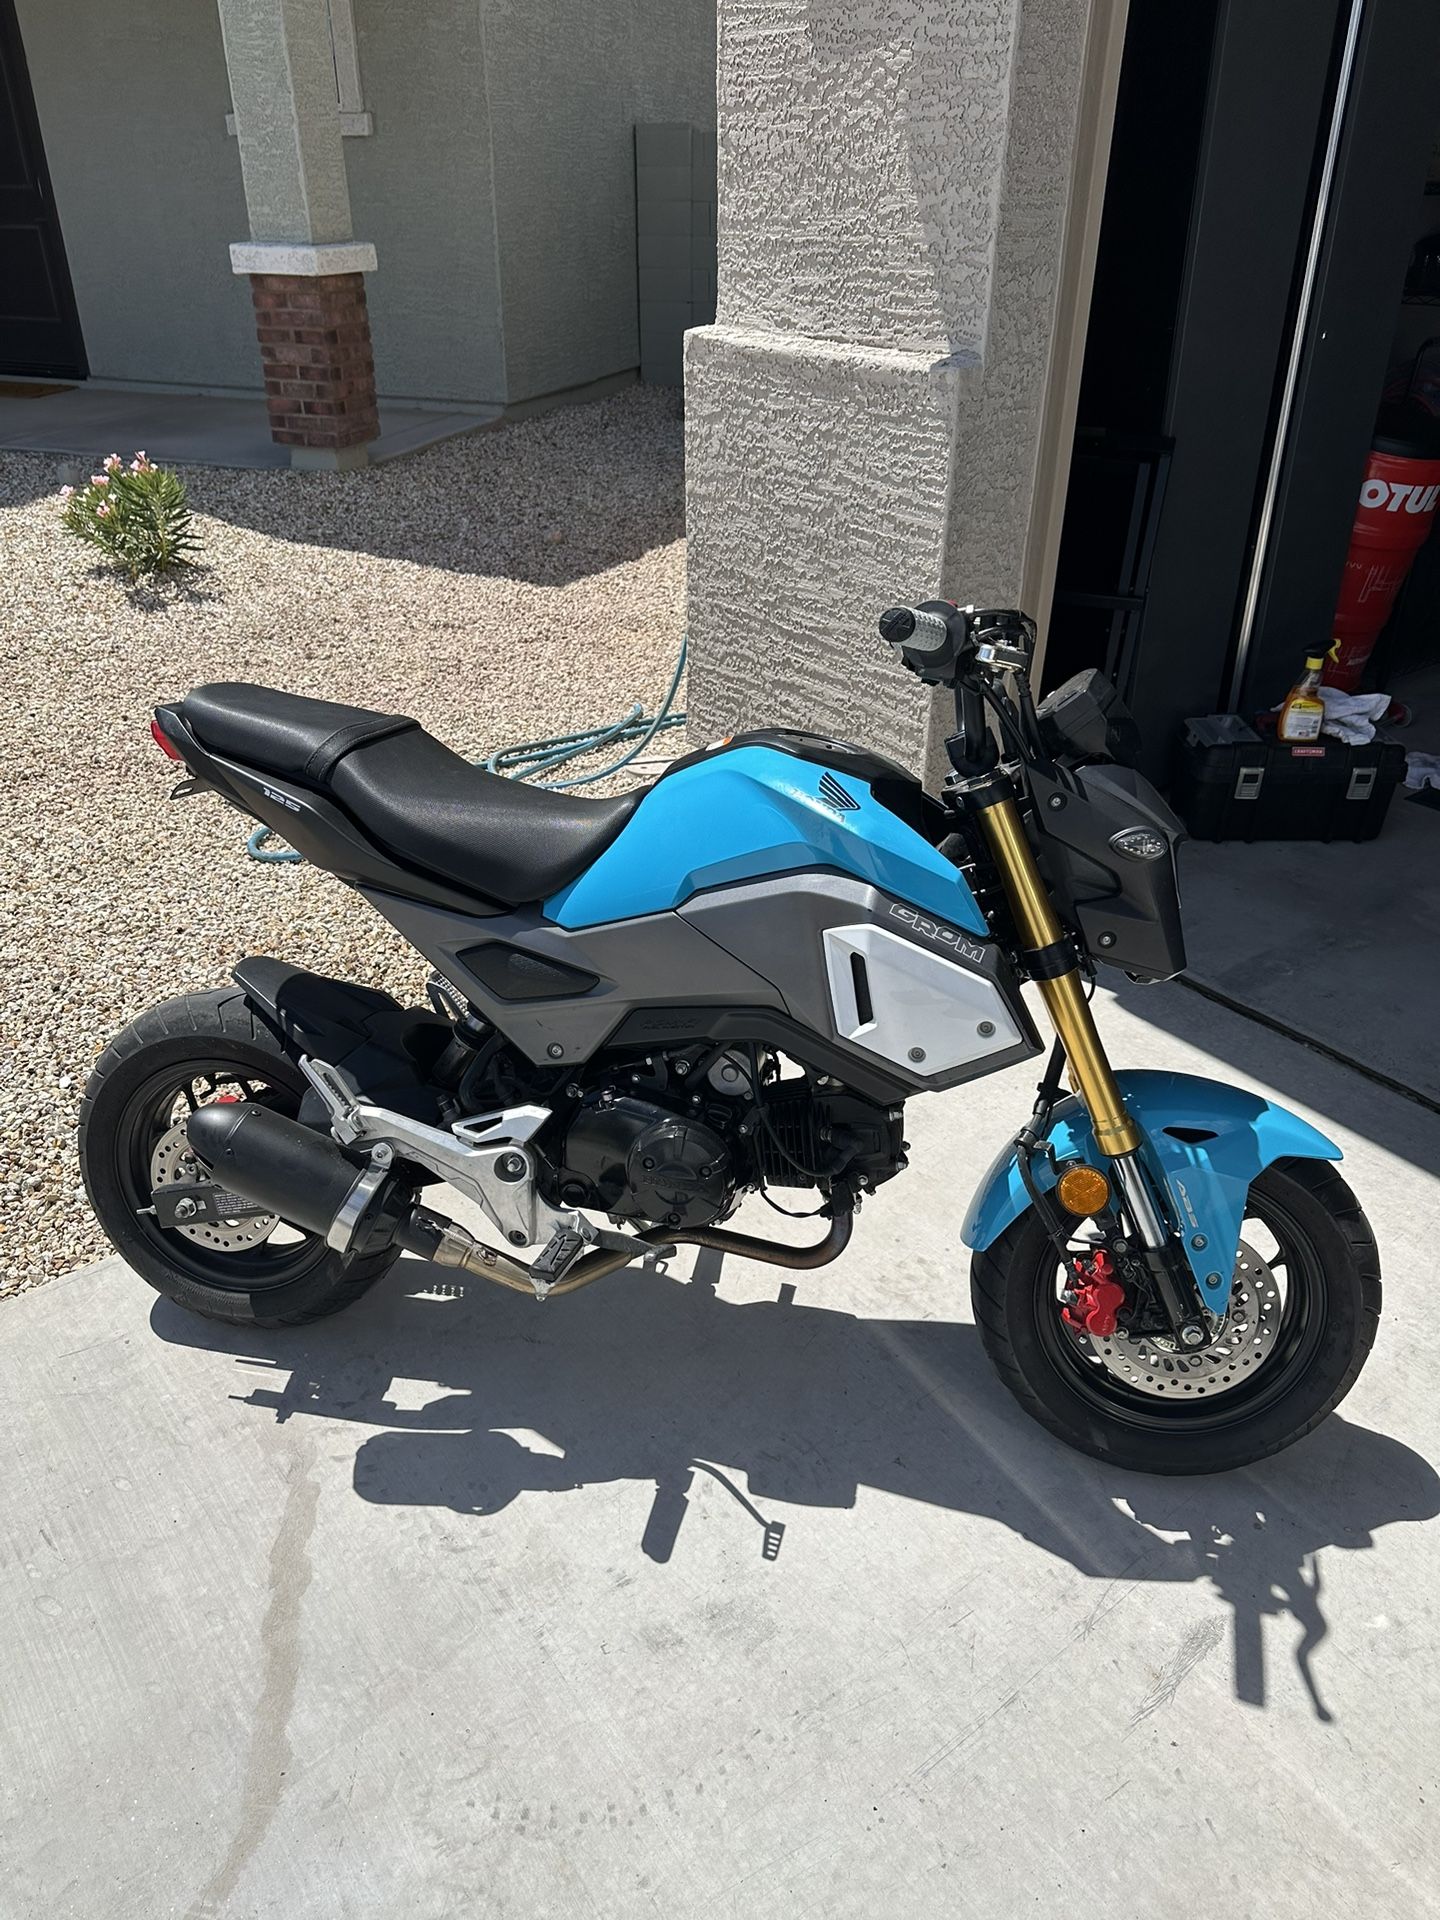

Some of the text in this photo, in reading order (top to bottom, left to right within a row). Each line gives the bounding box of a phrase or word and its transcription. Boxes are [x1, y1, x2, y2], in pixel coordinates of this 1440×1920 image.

[263, 787, 301, 812] 125
[889, 903, 986, 963] GROM
[1176, 1179, 1199, 1228] ABS
